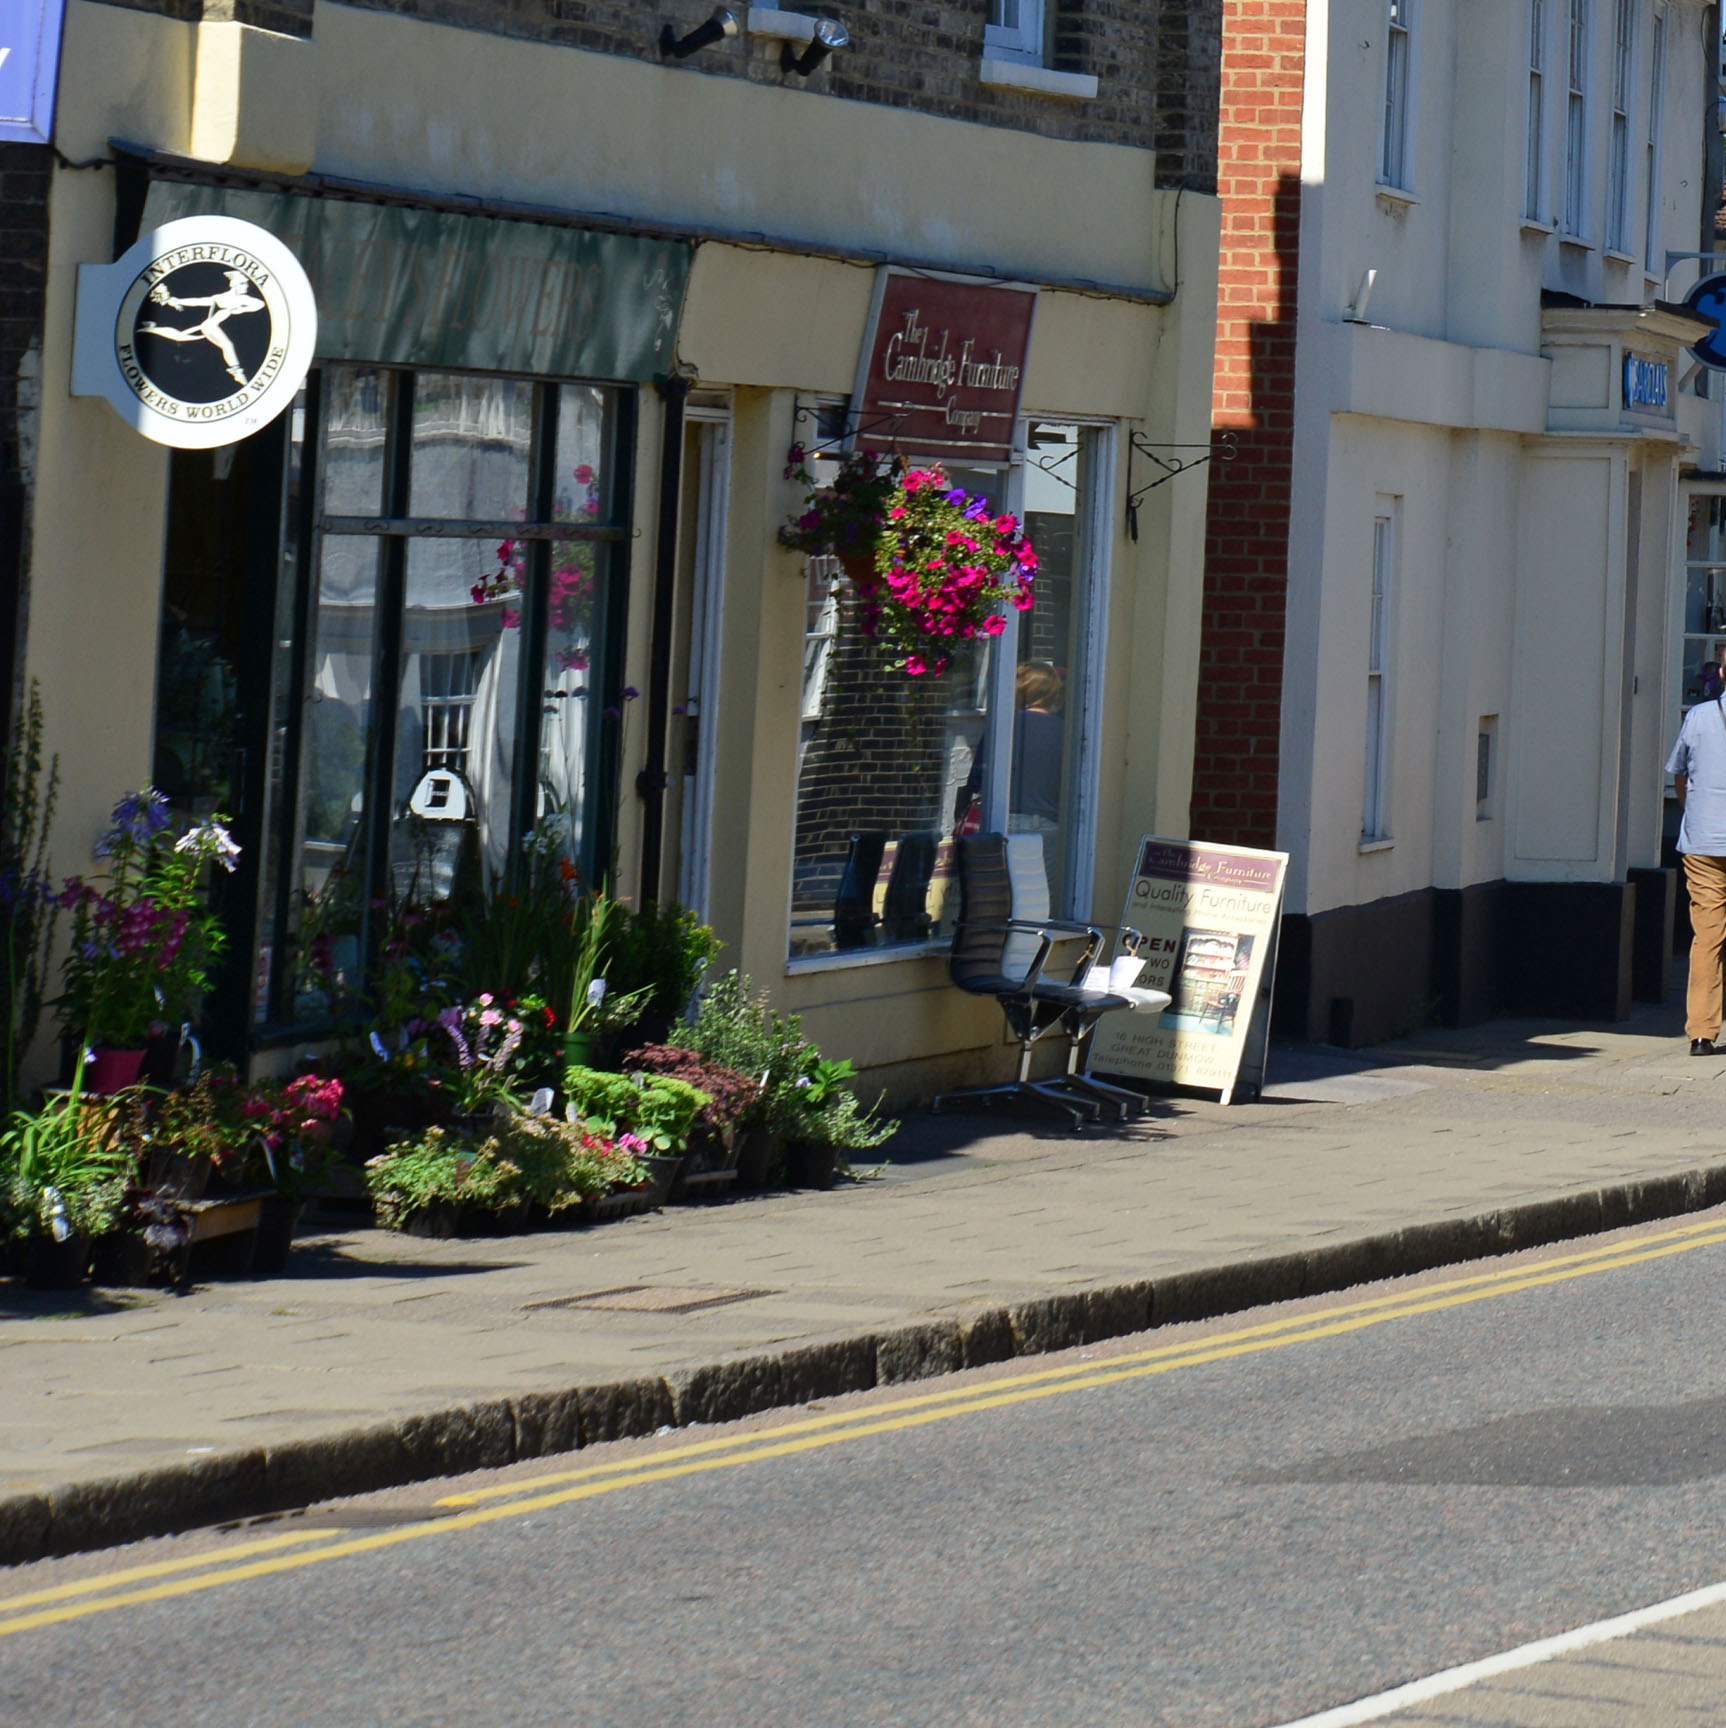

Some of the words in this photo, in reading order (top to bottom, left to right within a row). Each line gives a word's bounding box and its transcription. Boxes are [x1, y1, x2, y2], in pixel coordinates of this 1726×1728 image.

[140, 245, 270, 289] INTERFLORA
[902, 308, 923, 344] The
[118, 343, 180, 416] FLOWERS
[186, 392, 250, 420] WORLD
[250, 345, 285, 393] WIDE
[884, 326, 957, 399] Cambridge
[956, 337, 1020, 391] Furniture
[945, 394, 983, 436] Company
[1216, 860, 1272, 881] Furniture
[1134, 879, 1195, 908] Quality
[1199, 888, 1272, 915] Furniture
